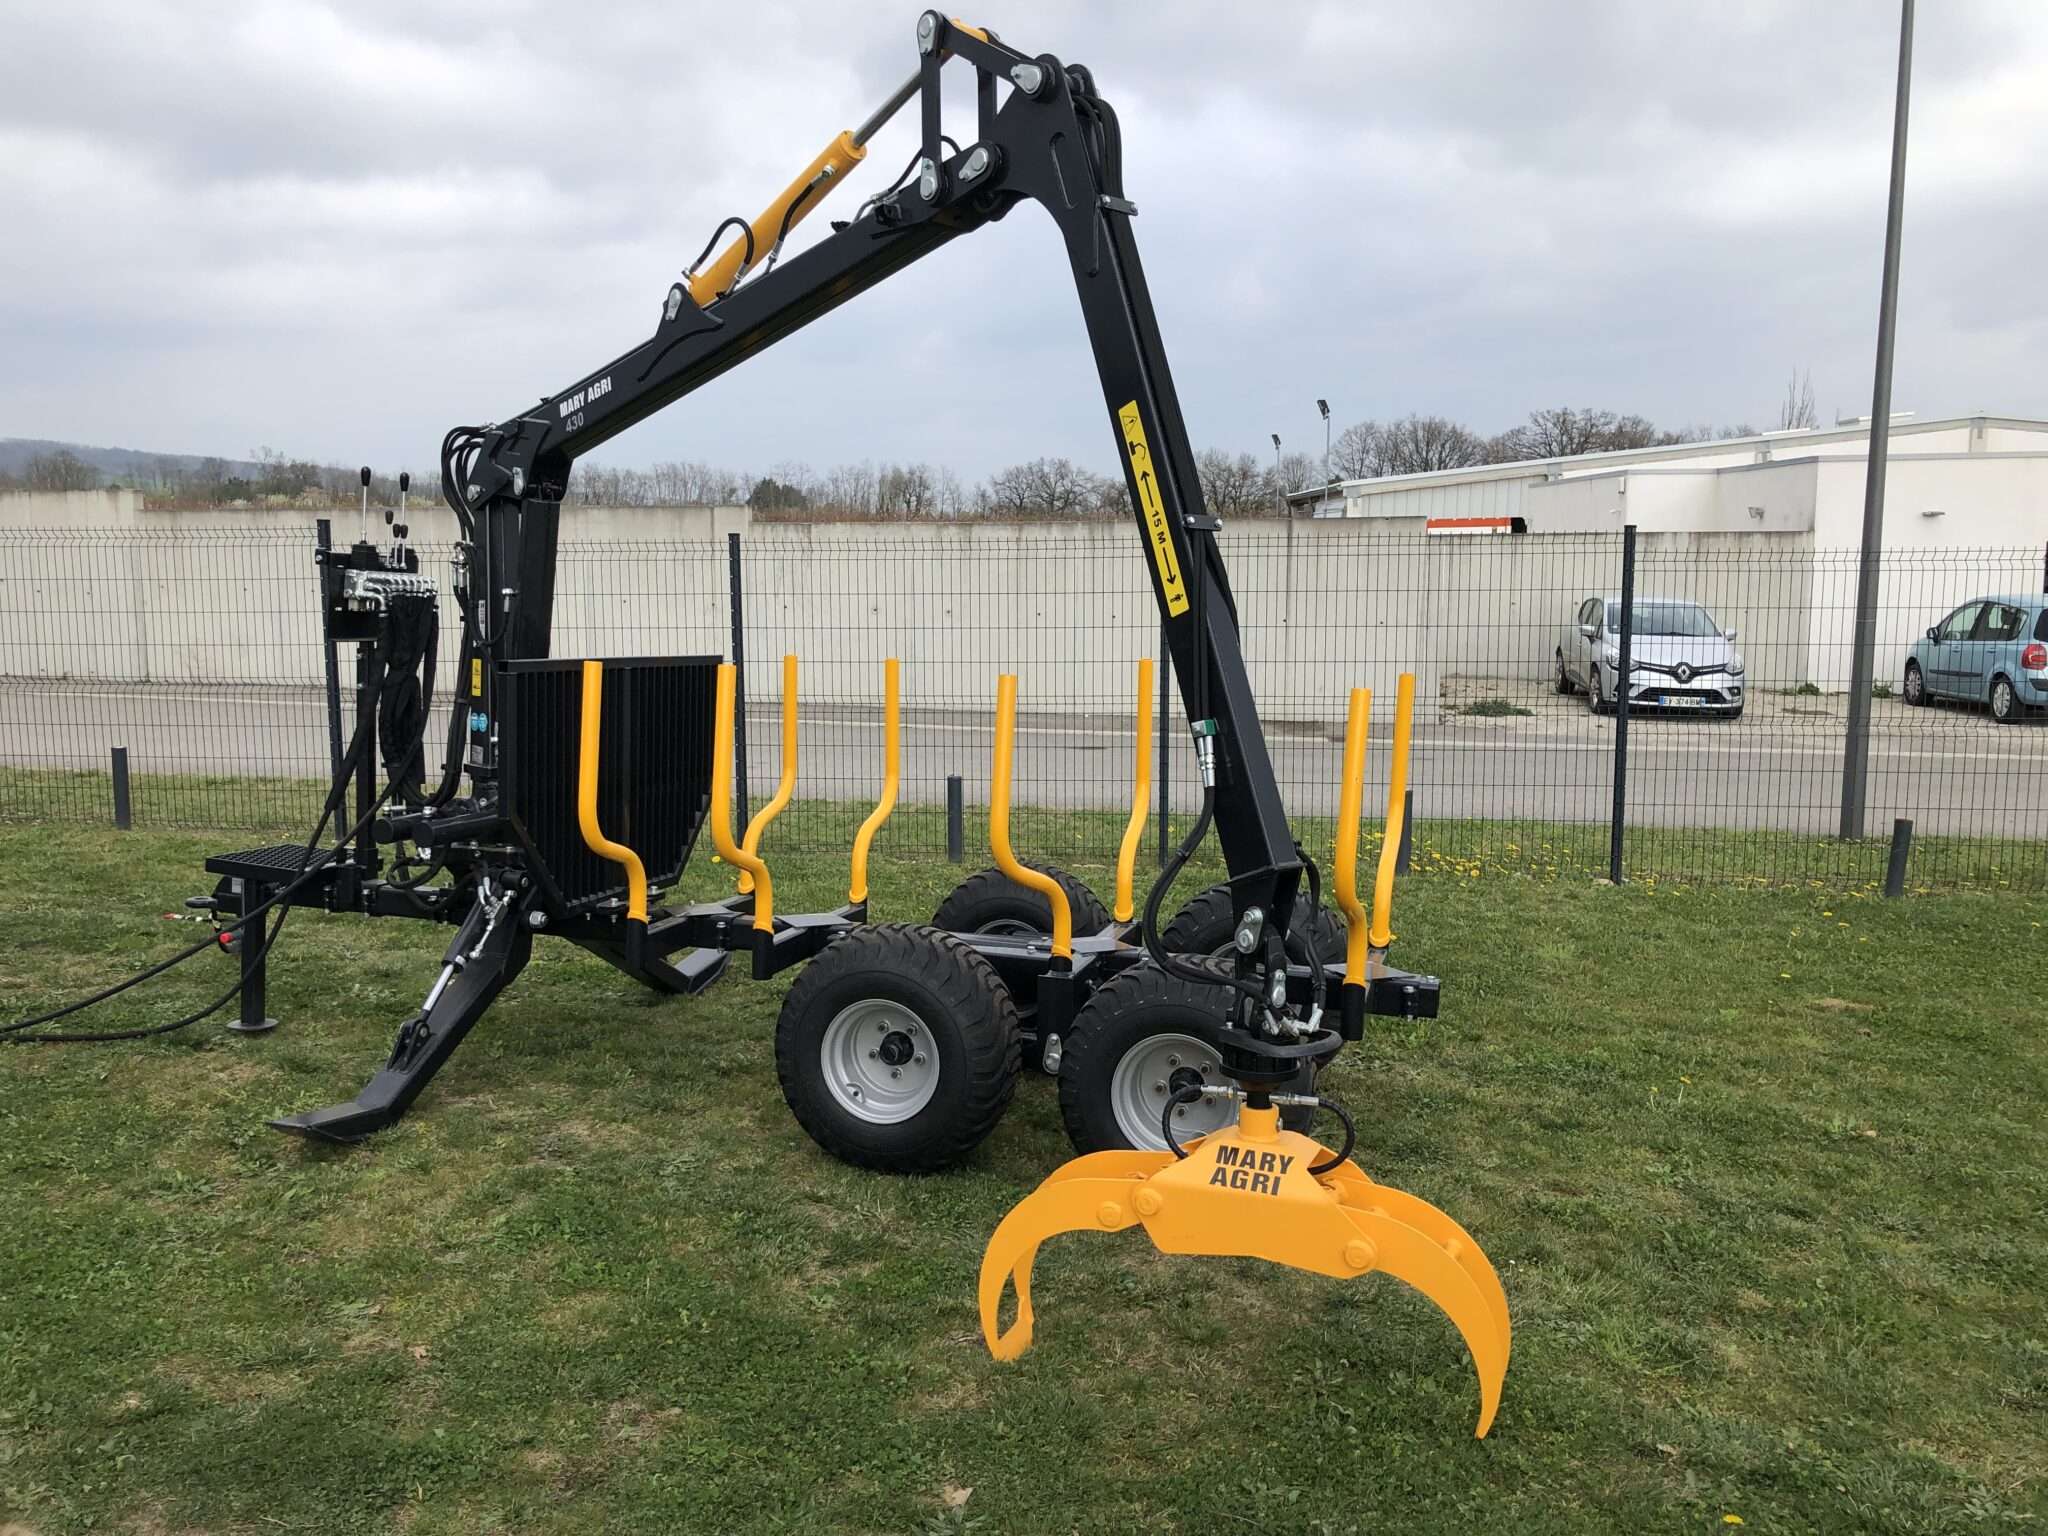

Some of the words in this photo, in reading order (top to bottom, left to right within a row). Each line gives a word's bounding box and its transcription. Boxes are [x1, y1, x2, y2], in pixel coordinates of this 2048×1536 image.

[560, 391, 585, 418] MARY
[587, 376, 612, 403] AGRI
[566, 411, 584, 432] 430
[1152, 510, 1162, 528] 15
[1157, 531, 1166, 544] M
[1216, 1144, 1295, 1174] MARY
[1209, 1166, 1281, 1196] AGRI
